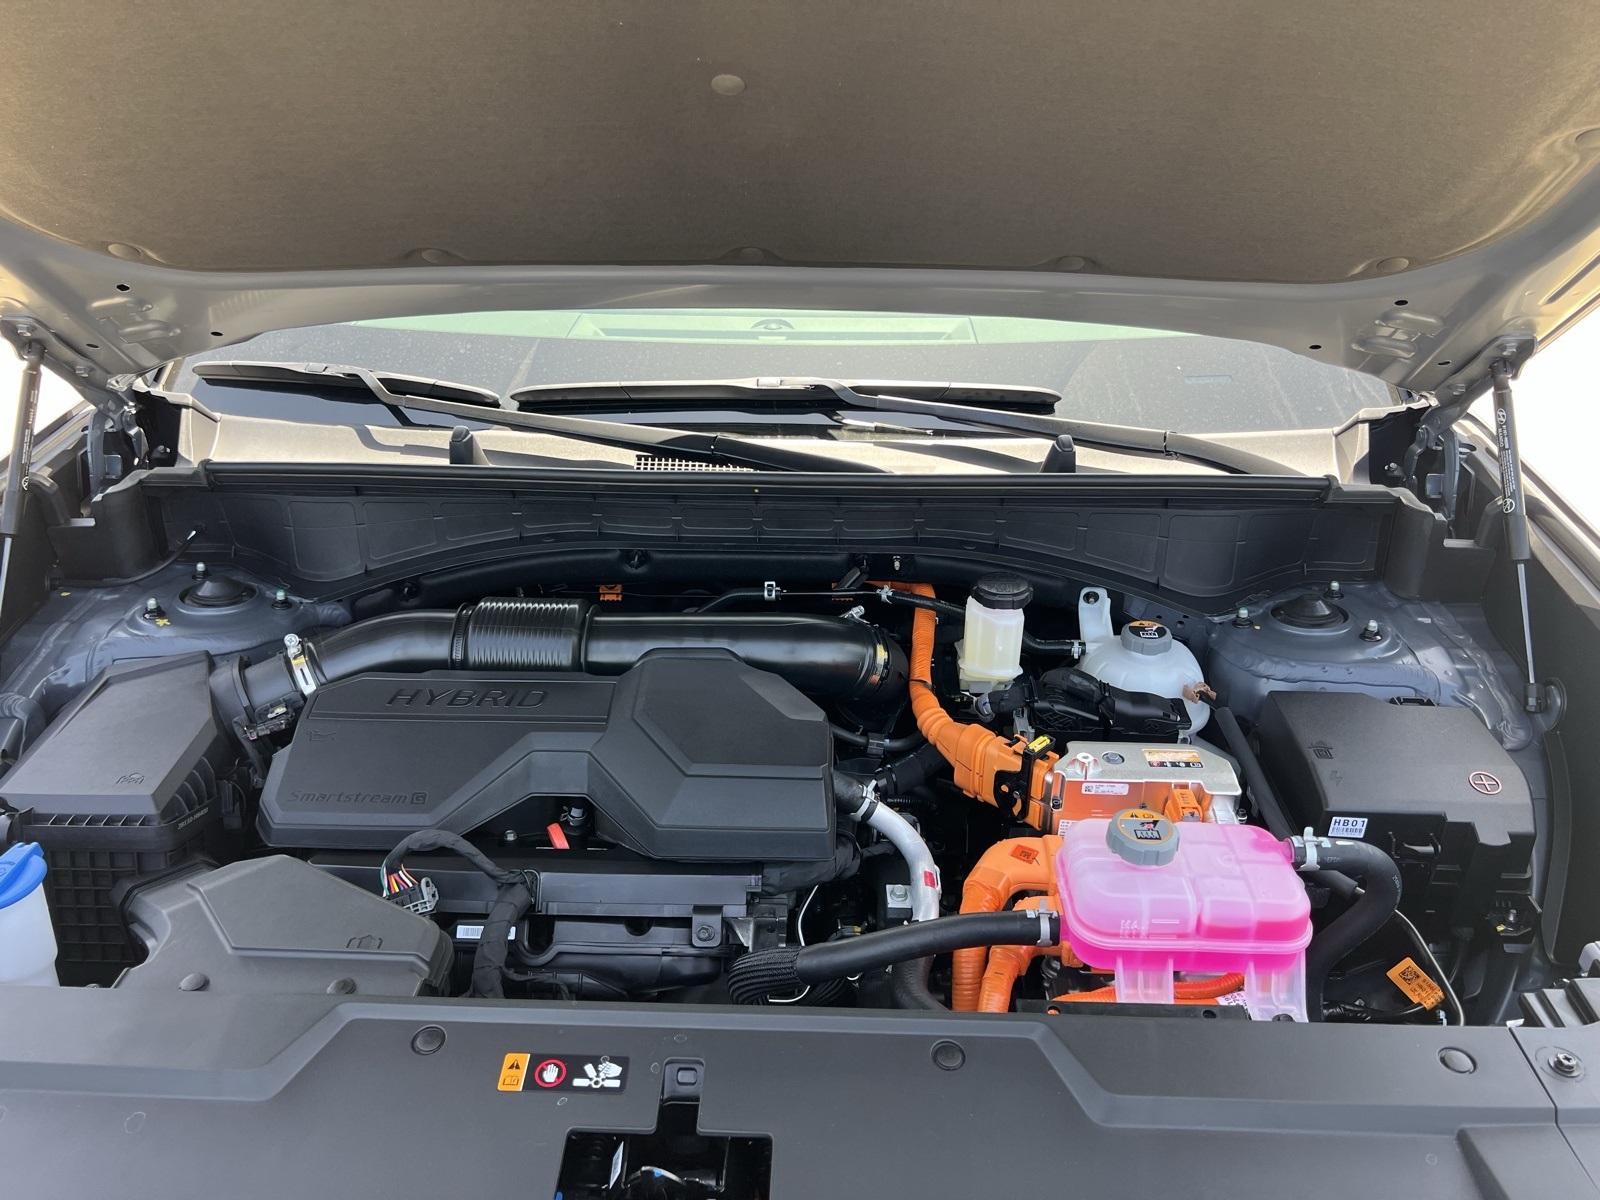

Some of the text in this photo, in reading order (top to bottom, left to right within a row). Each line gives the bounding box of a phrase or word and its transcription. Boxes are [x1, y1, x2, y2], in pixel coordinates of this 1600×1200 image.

[386, 688, 548, 708] HYBRID
[288, 789, 408, 804] Smartstream
[1333, 819, 1365, 828] HB01
